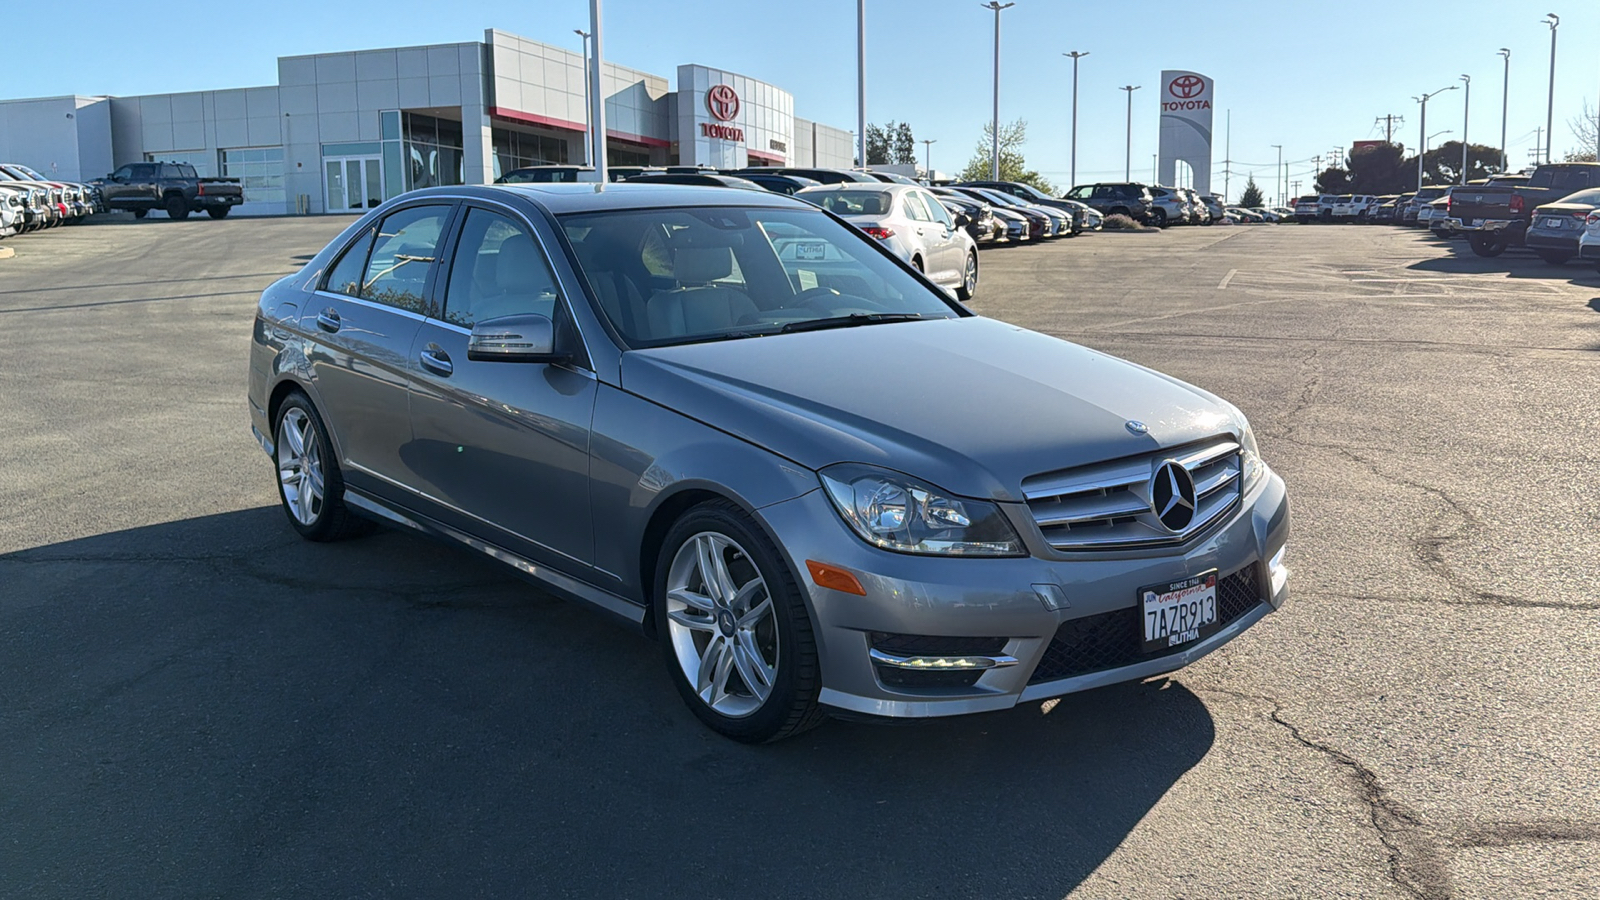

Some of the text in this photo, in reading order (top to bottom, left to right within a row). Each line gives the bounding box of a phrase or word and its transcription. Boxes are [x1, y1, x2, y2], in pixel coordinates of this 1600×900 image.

[1162, 100, 1211, 112] TOYOTA
[701, 122, 745, 142] TOYOTA
[803, 244, 823, 253] LITHIA
[1169, 580, 1187, 591] SINCE
[1145, 593, 1157, 603] JUN
[1158, 583, 1206, 604] California
[1147, 595, 1215, 640] 7AZR913
